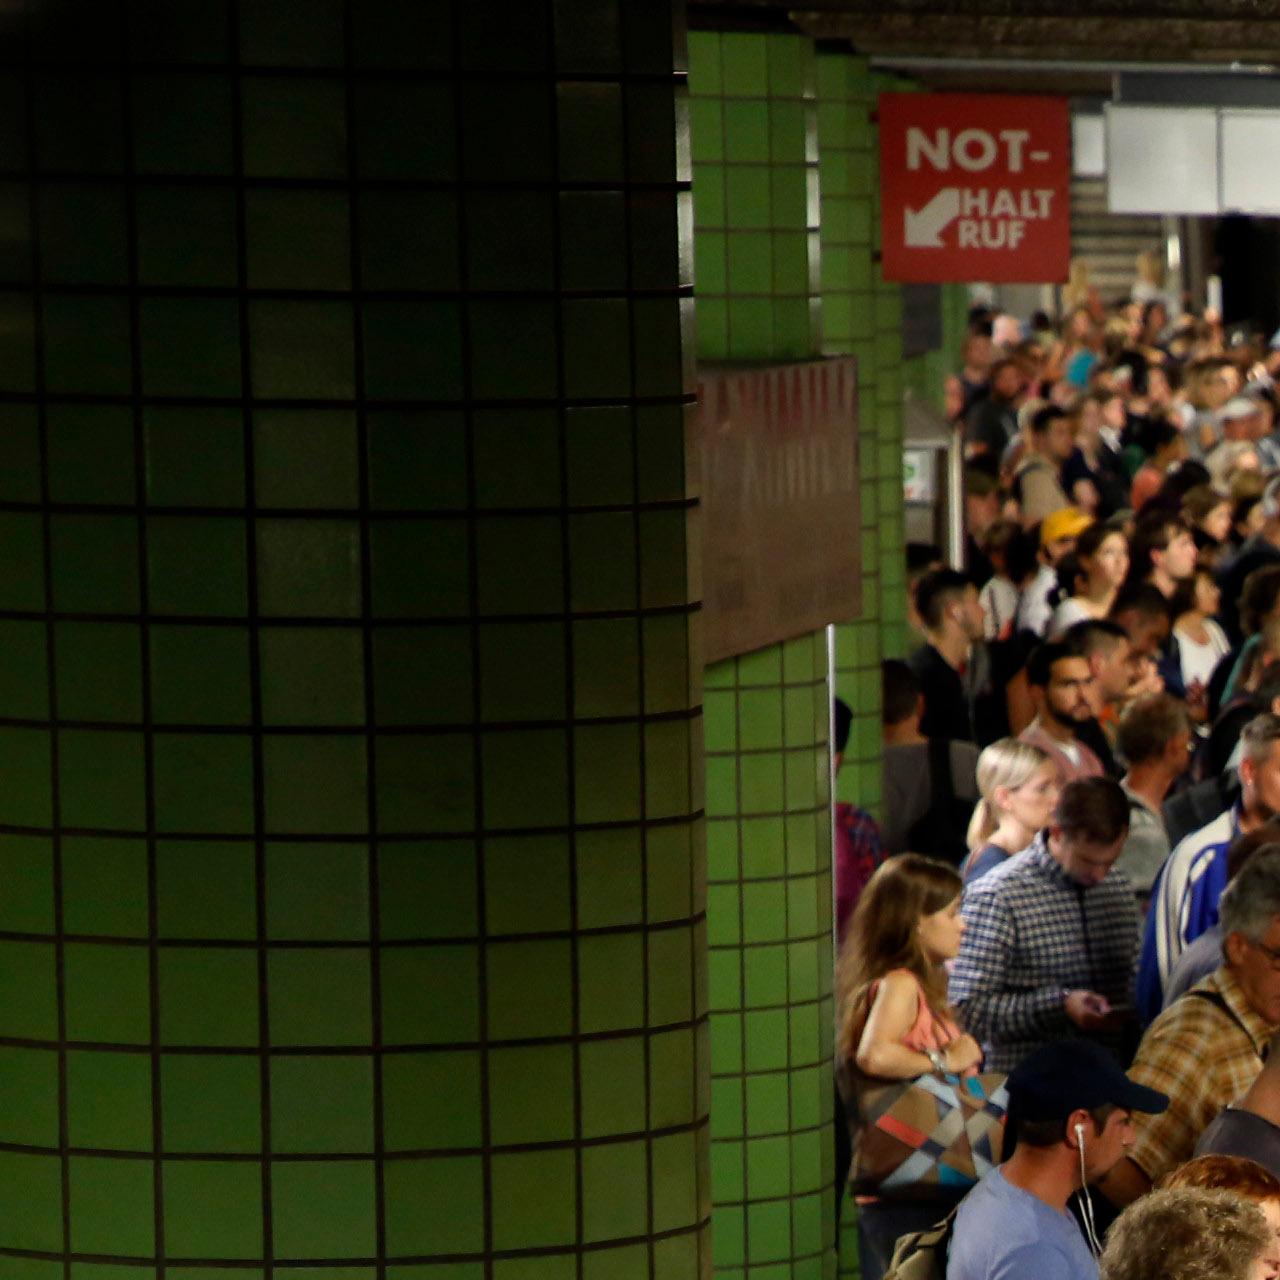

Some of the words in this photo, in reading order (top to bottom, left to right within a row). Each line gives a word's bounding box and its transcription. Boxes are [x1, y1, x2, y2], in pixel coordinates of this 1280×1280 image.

[906, 127, 1050, 172] NOT-
[962, 188, 1055, 219] HALT
[958, 219, 1026, 249] RUF
